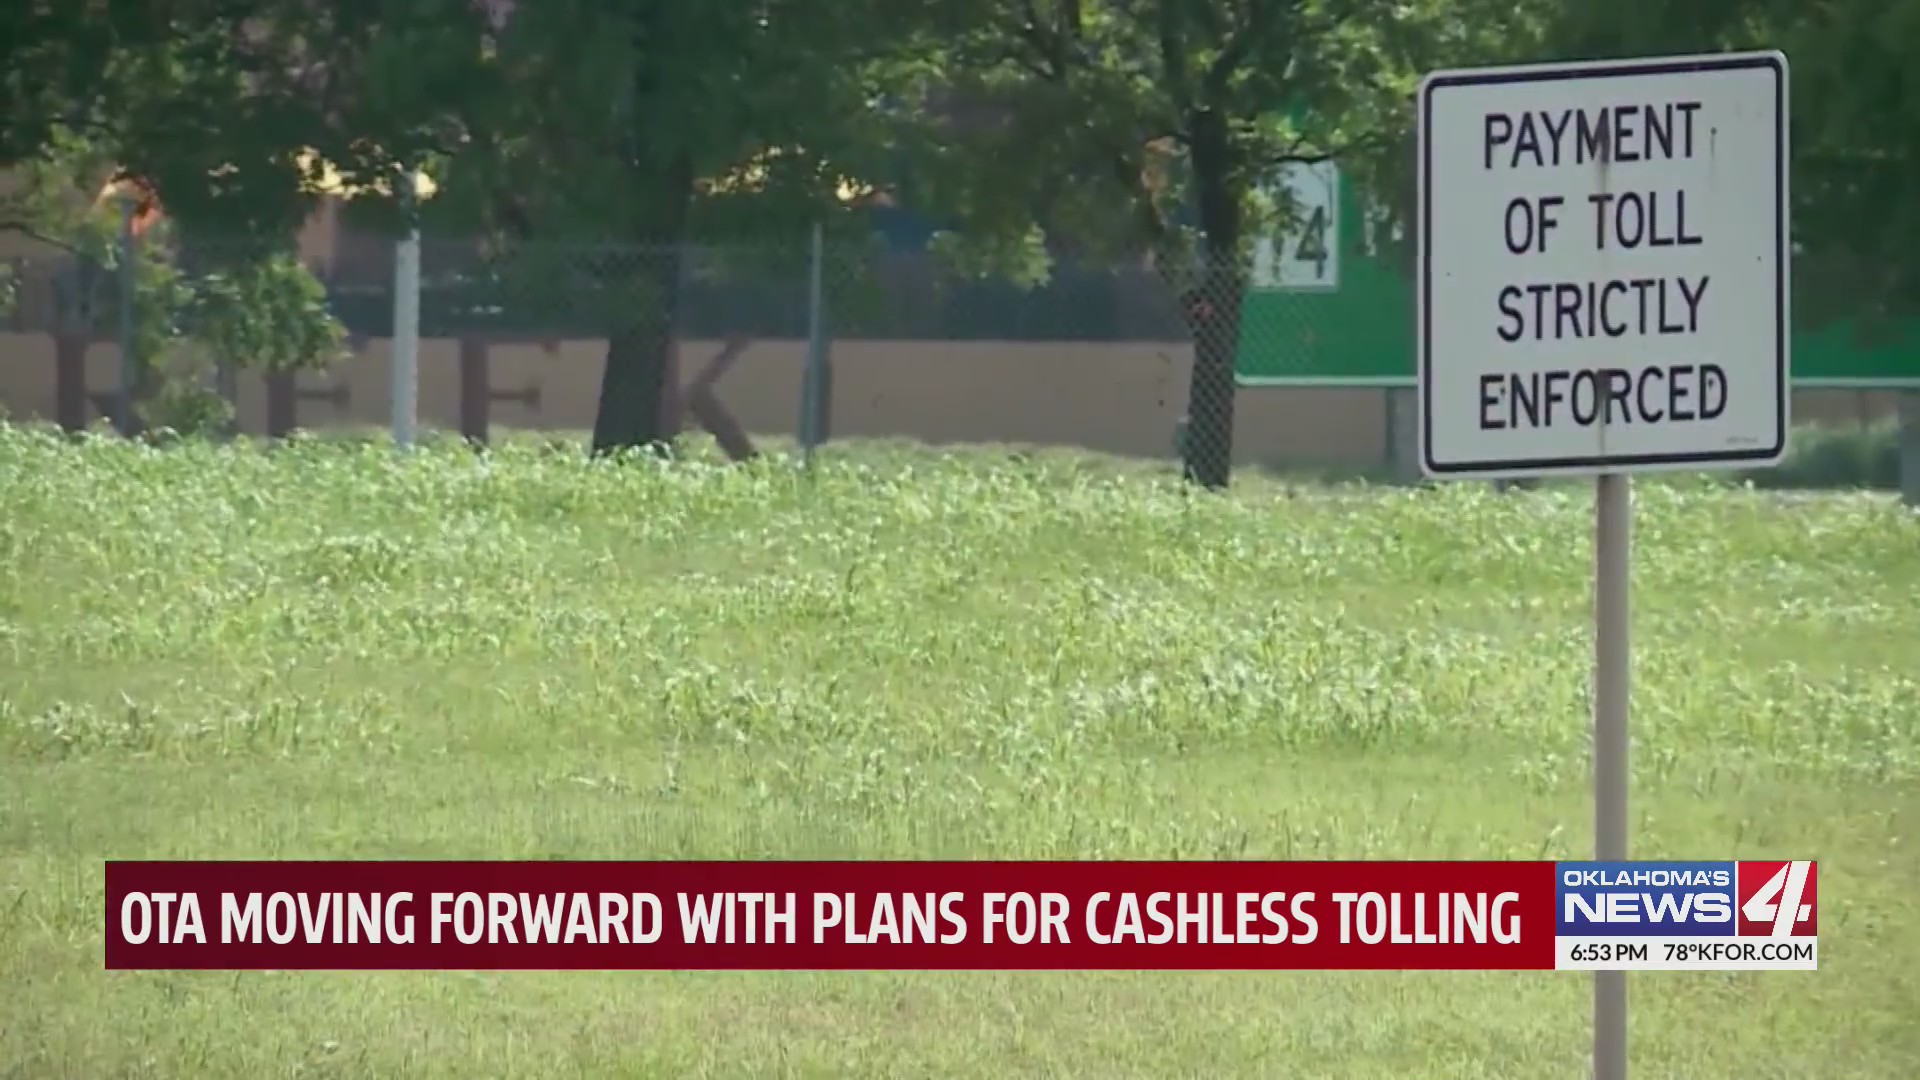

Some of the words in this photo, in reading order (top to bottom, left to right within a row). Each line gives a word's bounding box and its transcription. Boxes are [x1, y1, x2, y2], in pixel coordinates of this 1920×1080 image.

[1484, 102, 1702, 169] PAYMENT
[1504, 196, 1563, 254] OF
[1589, 190, 1703, 250] TOLL
[1496, 276, 1710, 342] STRICTLY
[1479, 364, 1728, 430] ENFORCED
